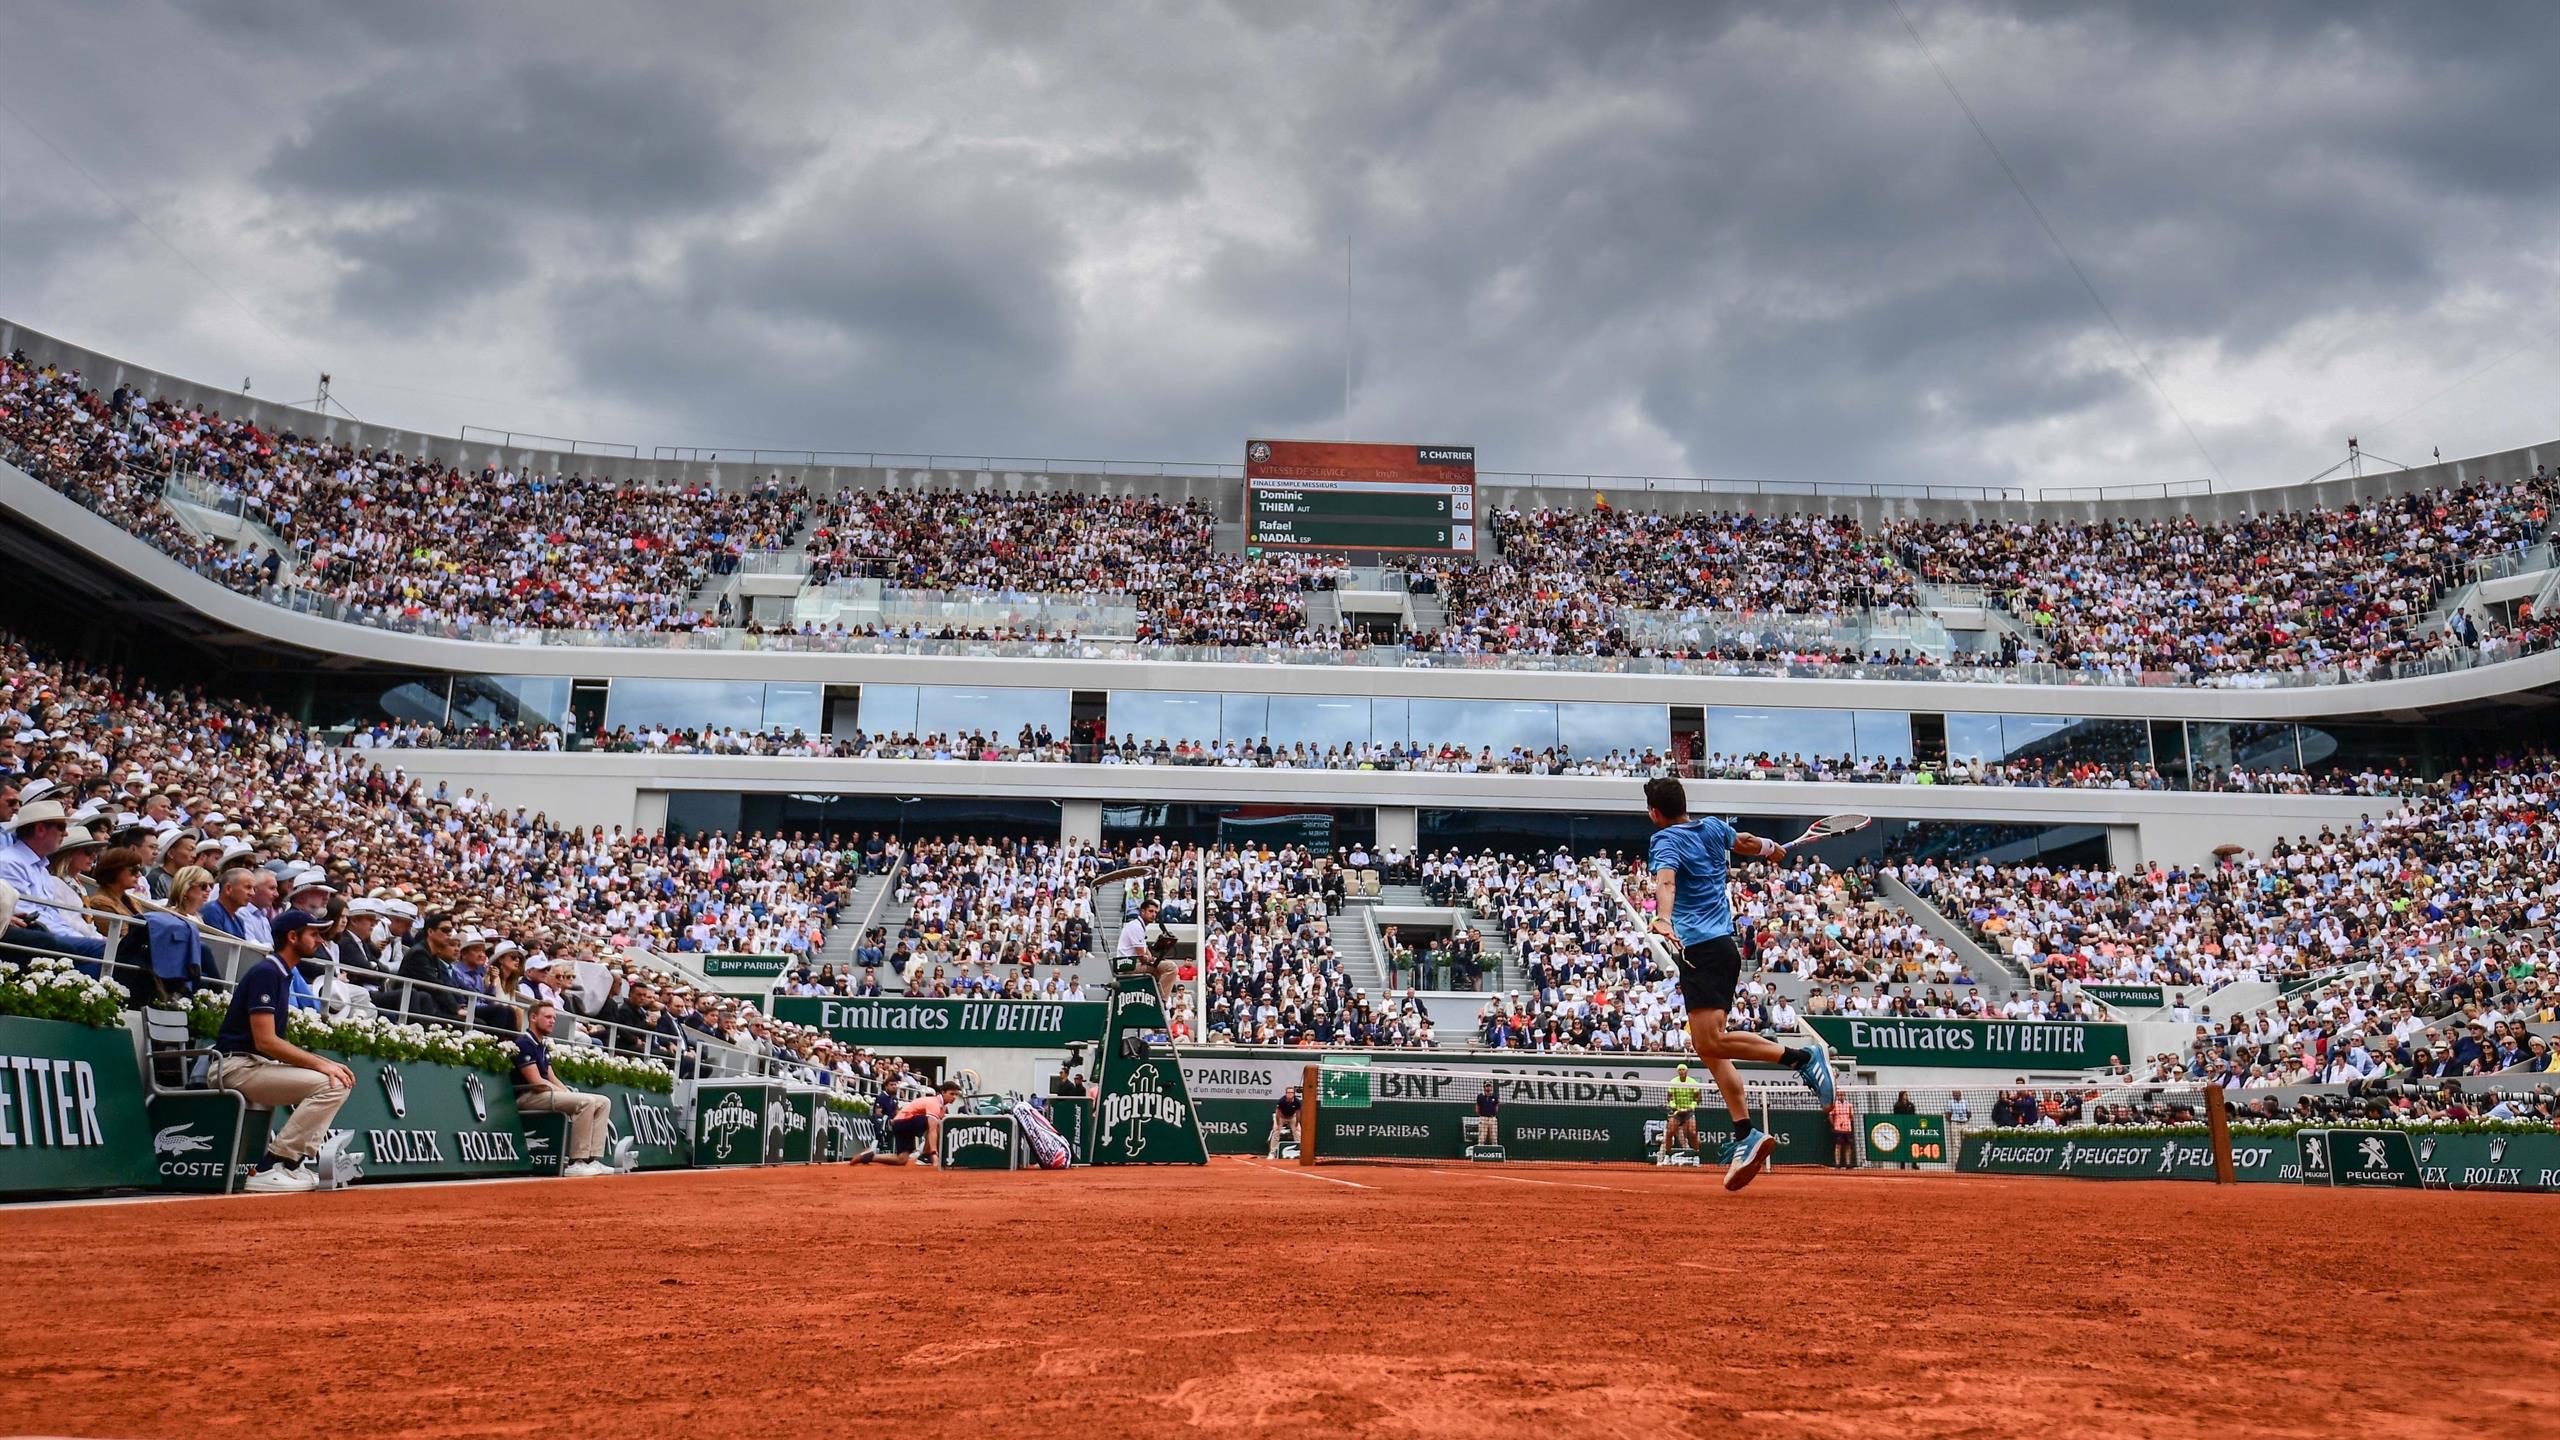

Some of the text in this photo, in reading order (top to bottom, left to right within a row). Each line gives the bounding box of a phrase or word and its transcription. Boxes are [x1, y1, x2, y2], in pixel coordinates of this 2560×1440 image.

[1420, 451, 1472, 460] P. CHATRIER
[1260, 466, 1345, 477] VITESSE DE SERVICE
[1260, 490, 1303, 500] Dominic
[1451, 485, 1470, 493] 0:39
[1259, 502, 1294, 512] THIEM
[1437, 501, 1445, 511] 3
[1455, 502, 1469, 511] 40
[1259, 520, 1292, 531] Rafael
[1259, 533, 1312, 544] NADAL ESP
[1437, 531, 1445, 541] 3
[1458, 532, 1466, 541] A
[721, 961, 785, 970] BNP PARIBAS
[2099, 991, 2160, 1000] BNP PARIBAS
[1117, 989, 1156, 1016] perrier
[821, 1001, 1064, 1032] Emirates FLY BETTER
[1850, 1021, 2084, 1053] Emirates FLY BETTER
[1198, 1069, 1272, 1086] PARIBAS
[1378, 1066, 1643, 1103] BNP PARIBAS
[1248, 1087, 1273, 1096] change
[1102, 1086, 1187, 1146] perrier
[626, 1092, 677, 1155] Infosys
[703, 1102, 758, 1144] perrier
[1200, 1121, 1248, 1134] ARIBAS
[1335, 1124, 1430, 1137] BNP PARIBAS
[1517, 1127, 1610, 1141] BNP PARIBAS
[1697, 1131, 1726, 1143] BNP
[370, 1129, 444, 1163] ROLEX
[458, 1131, 519, 1161] ROLEX
[946, 1121, 1008, 1166] perrier
[530, 1155, 557, 1165] OSTE
[1991, 1147, 2054, 1163] PEUGEOT
[2074, 1148, 2151, 1165] PEUGEOT
[2177, 1148, 2273, 1168] PEUEOT
[160, 1162, 224, 1177] COSTE
[2279, 1164, 2303, 1179] ROL
[2346, 1171, 2405, 1180] PEUGEOT
[2419, 1167, 2448, 1183] LEX
[2463, 1167, 2521, 1185] ROLEX
